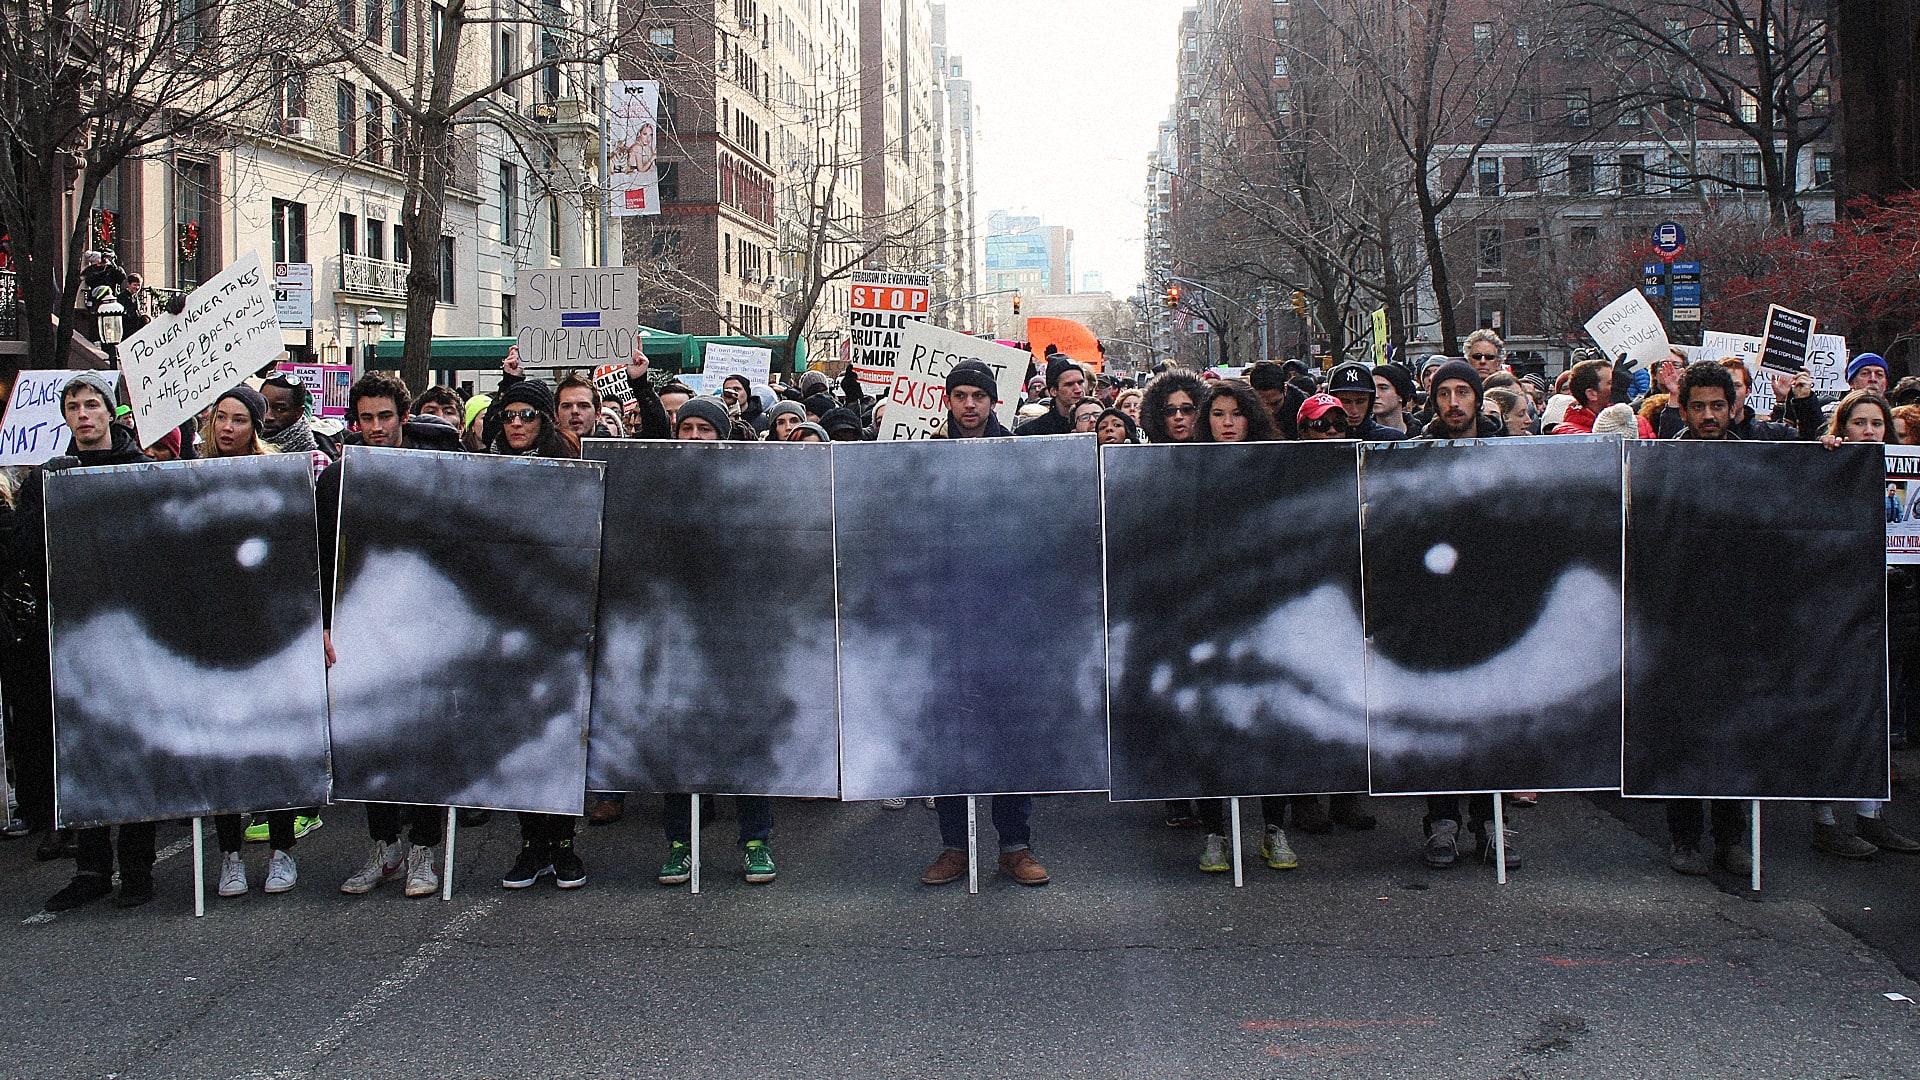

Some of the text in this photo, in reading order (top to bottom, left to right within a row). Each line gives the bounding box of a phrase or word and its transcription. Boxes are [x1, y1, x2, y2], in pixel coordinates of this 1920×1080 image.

[852, 270, 930, 287] FERGUSON IS EVERYWHERE
[1645, 265, 1656, 274] M1
[1645, 276, 1658, 285] M2
[278, 290, 285, 300] 2
[528, 272, 625, 312] SILENCE
[853, 287, 925, 310] STOP
[1645, 286, 1658, 295] M3
[1597, 300, 1642, 335] ENOUGH
[1772, 320, 1797, 331] DEFENDERS
[1778, 313, 1803, 326] NYC PUBLIC
[130, 323, 182, 364] POWER
[184, 295, 223, 333] NEVER
[851, 328, 904, 348] BRUTAL
[1620, 324, 1632, 334] IS
[518, 325, 639, 364] COMPLACENCY
[1611, 323, 1661, 357] ENOUGH
[1705, 336, 1740, 353] WHITE
[1811, 336, 1843, 350] MANY
[142, 375, 153, 390] A
[198, 313, 235, 356] BACK
[852, 347, 899, 368] & MUR
[183, 350, 220, 384] FACE
[909, 343, 1008, 383] REST
[1814, 366, 1830, 377] BE
[594, 370, 627, 388] OLIC
[1346, 369, 1359, 382] NY
[15, 377, 63, 410] BLACK
[177, 361, 238, 409] POWER
[1886, 457, 1920, 474] WANT
